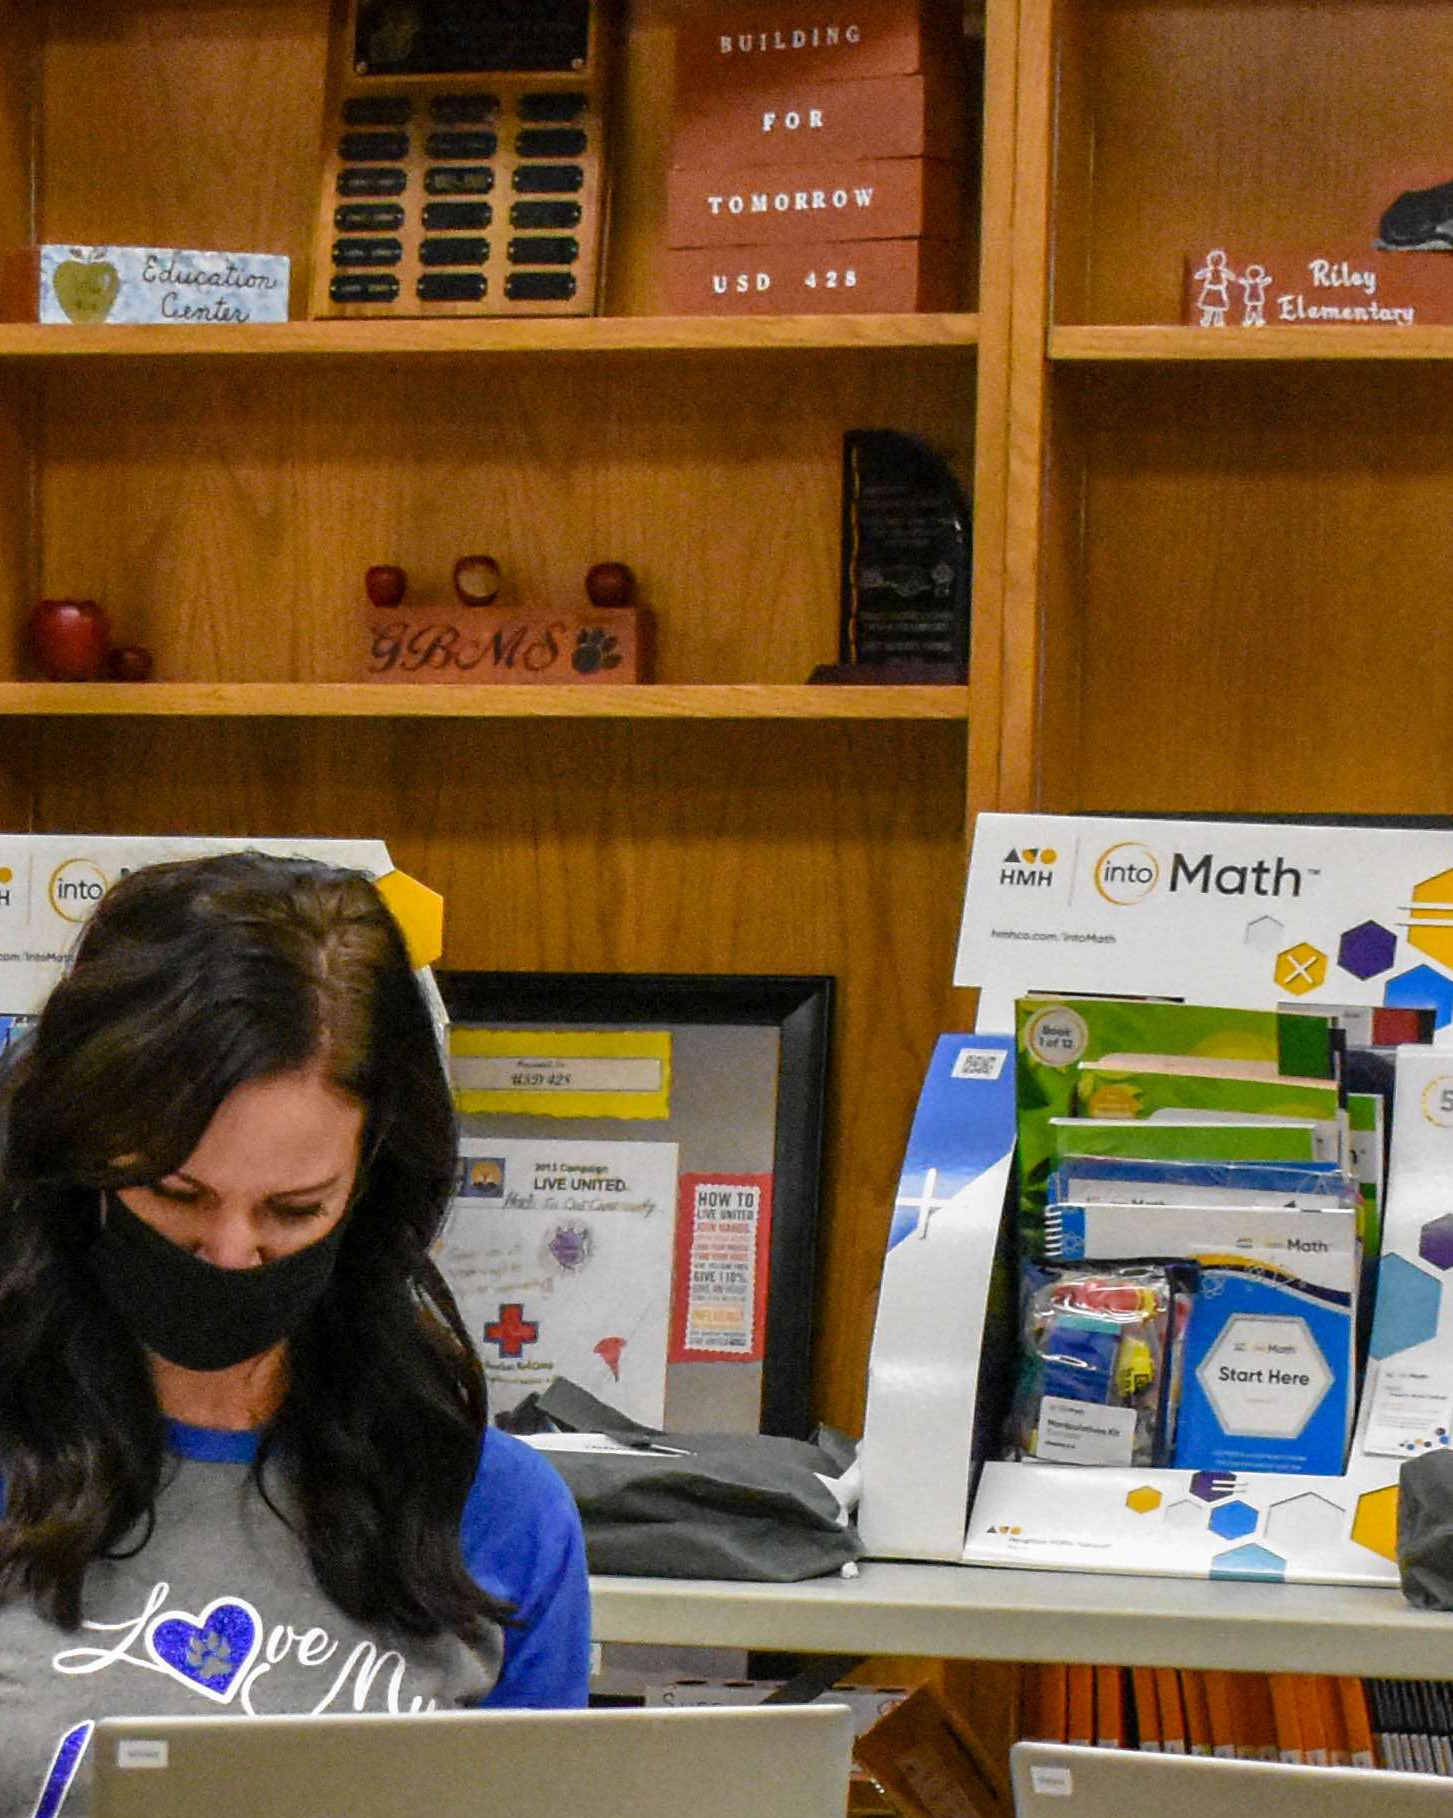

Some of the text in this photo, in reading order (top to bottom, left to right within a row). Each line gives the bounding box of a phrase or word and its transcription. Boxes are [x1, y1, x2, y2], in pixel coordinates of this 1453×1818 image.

[720, 26, 860, 54] BUILDING
[763, 109, 823, 132] FOR
[708, 188, 873, 214] TOMORROW
[142, 255, 278, 290] Education
[713, 270, 857, 293] USD 428
[1308, 259, 1376, 295] Riley
[161, 292, 250, 323] Center
[1278, 295, 1416, 326] Elementary
[1000, 869, 1053, 887] HMH
[1104, 860, 1153, 884] into
[58, 879, 103, 900] into
[1060, 1038, 1074, 1049] 12
[534, 1179, 627, 1192] LIVE UNITED
[698, 1192, 754, 1207] HOW TO
[694, 1271, 715, 1282] GIVE
[1218, 1366, 1310, 1387] Start Here
